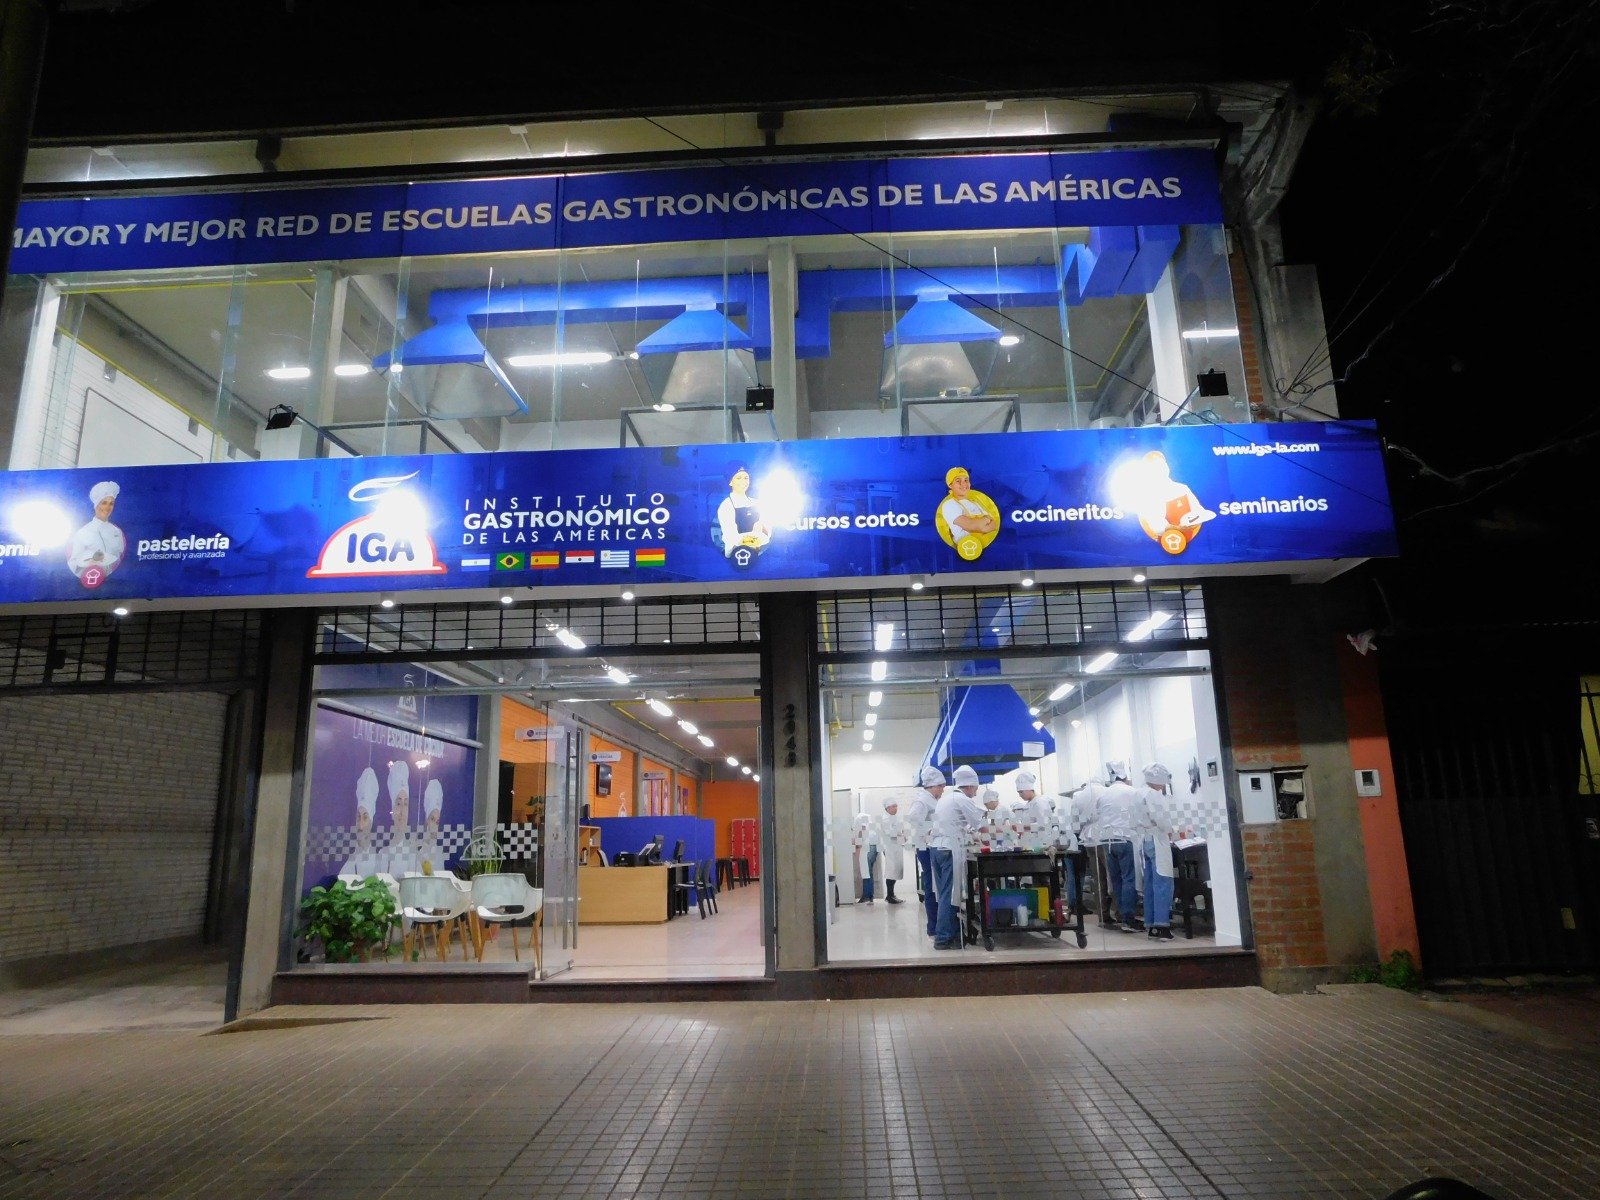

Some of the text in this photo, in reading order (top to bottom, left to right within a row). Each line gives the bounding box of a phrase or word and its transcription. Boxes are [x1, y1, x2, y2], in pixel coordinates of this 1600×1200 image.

[115, 223, 137, 244] Y
[144, 218, 246, 247] MEJOR
[256, 214, 319, 238] RED
[329, 212, 373, 234] DE
[382, 202, 552, 231] ESCUELAS
[563, 186, 868, 222] GASTRONÓMICAS
[878, 184, 923, 207] DE
[934, 181, 998, 205] LAS
[1004, 174, 1181, 202] AMÉRICAS
[1212, 442, 1320, 456] www.iga-la.com
[465, 493, 665, 511] INSTITUTO
[1219, 495, 1328, 516] seminarios
[463, 505, 670, 530] GASTRONÓMICO
[855, 511, 920, 528] cortos
[1011, 503, 1124, 523] cocineritos
[137, 532, 230, 556] pastelería
[463, 526, 666, 545] DE LAS AMÉRICAS
[139, 551, 182, 561] profesional
[188, 550, 226, 559] avanzada
[346, 532, 415, 563] IGA
